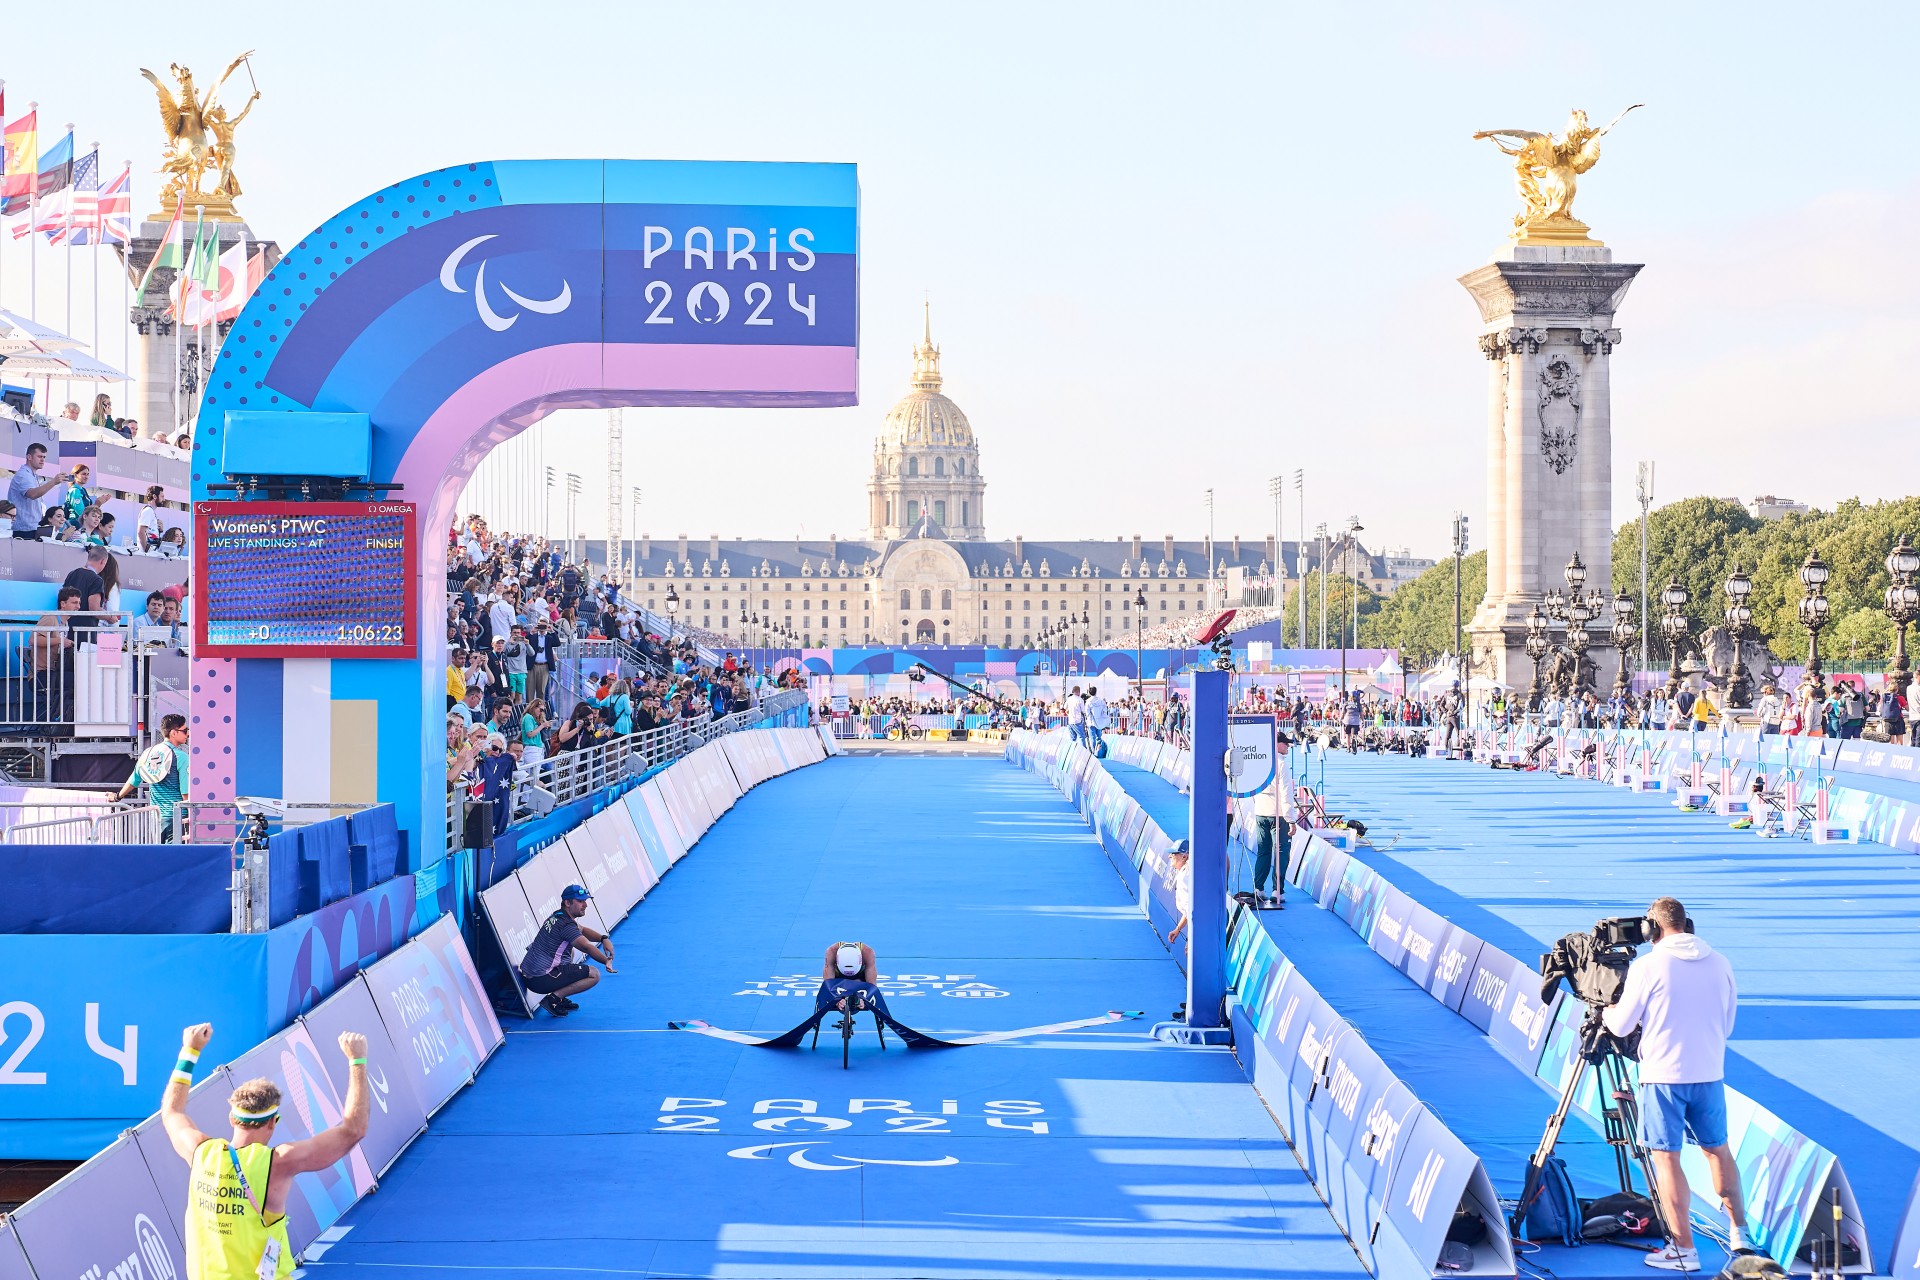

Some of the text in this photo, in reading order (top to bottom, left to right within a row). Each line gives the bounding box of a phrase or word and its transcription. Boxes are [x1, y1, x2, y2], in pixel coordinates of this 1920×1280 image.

[643, 280, 816, 326] 2024
[378, 505, 413, 513] OMEGA
[211, 519, 326, 534] Women's PTWC
[208, 538, 231, 548] LIVE
[233, 538, 297, 548] STANDINGS
[308, 538, 324, 548] AT
[366, 538, 403, 548] FINISH
[249, 625, 403, 641] +0 1:06:23
[1243, 752, 1267, 760] athlon
[1890, 753, 1914, 770] TOYOTA
[1472, 967, 1508, 1013] TOYOTA
[1508, 991, 1535, 1037] Allianz
[412, 1023, 450, 1076] 2024
[1328, 1057, 1362, 1121] TOYOTA
[651, 1114, 1050, 1134] 2024
[197, 1180, 248, 1199] PERSONAL
[199, 1197, 245, 1216] HANDLER
